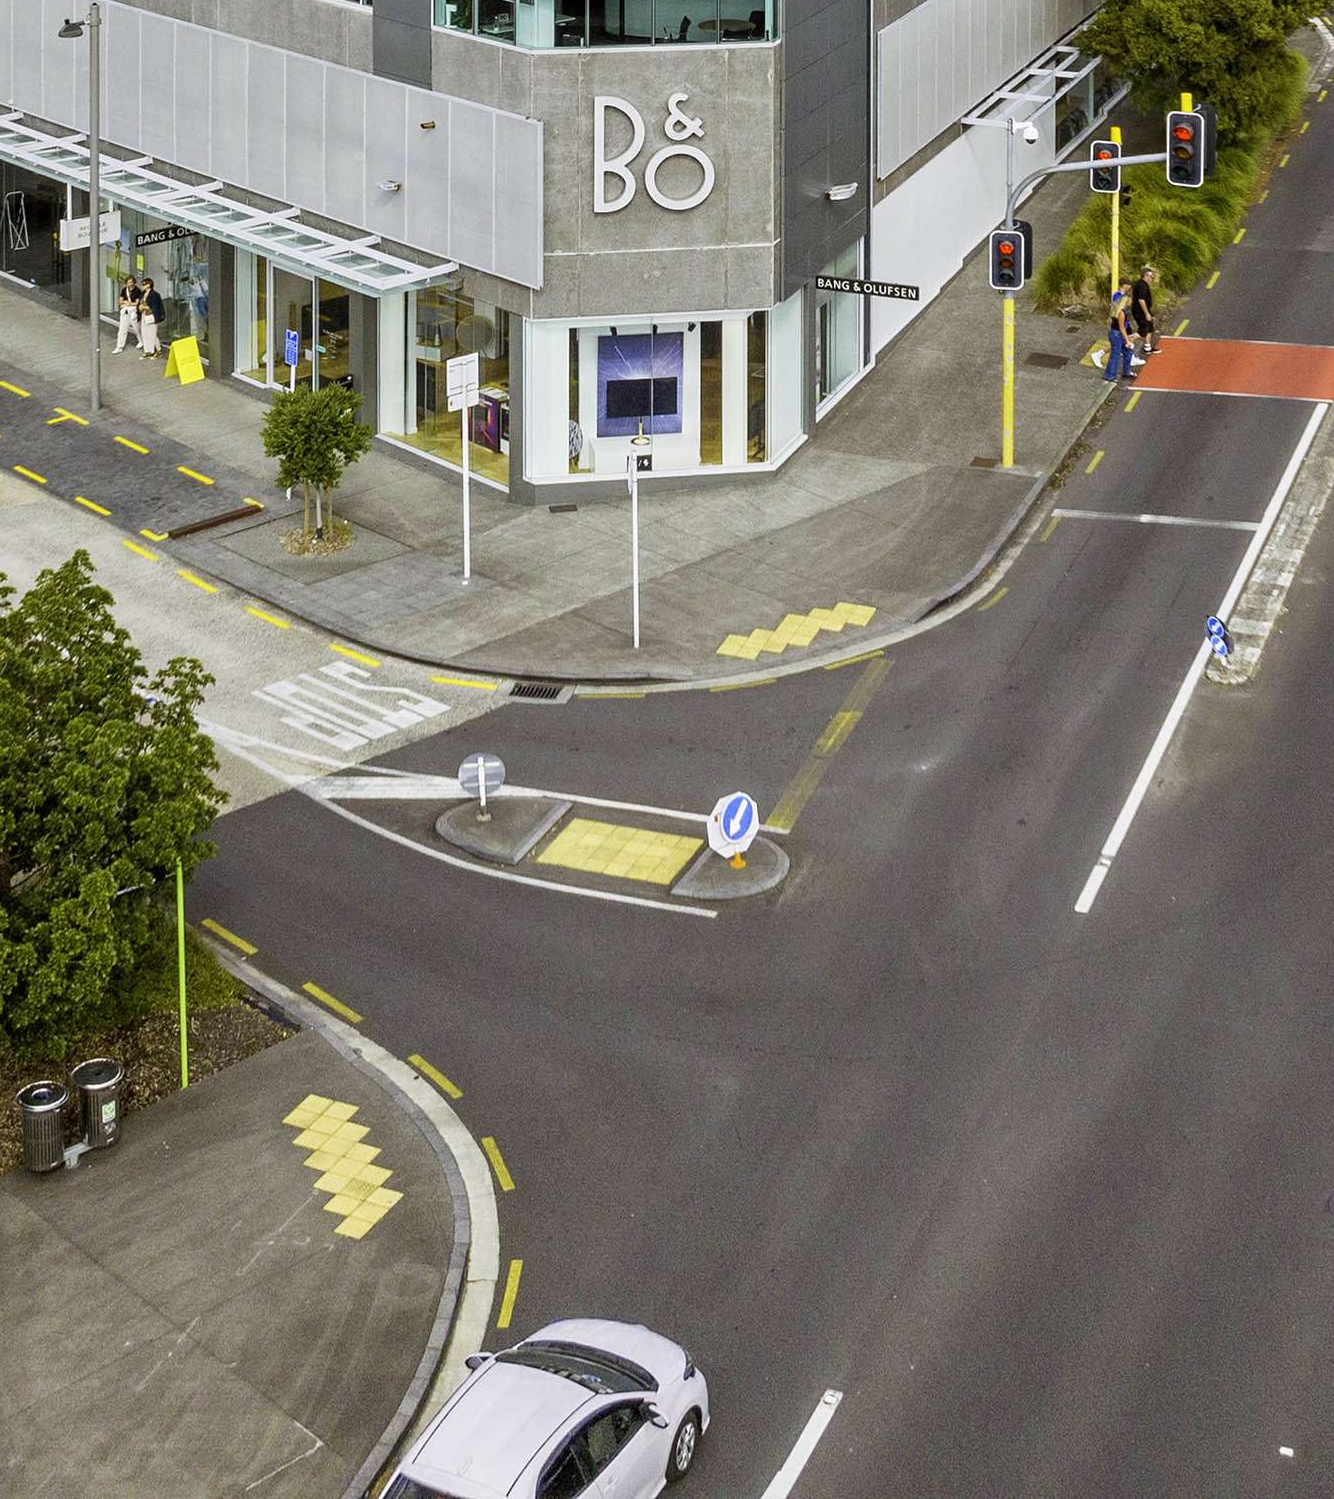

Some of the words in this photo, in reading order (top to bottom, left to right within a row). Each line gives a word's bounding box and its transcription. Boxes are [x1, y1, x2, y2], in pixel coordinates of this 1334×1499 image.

[594, 92, 716, 213] B&O
[137, 230, 166, 246] BANG
[817, 277, 850, 291] BANG
[853, 282, 861, 292] &
[863, 283, 917, 299] OLUFSEN
